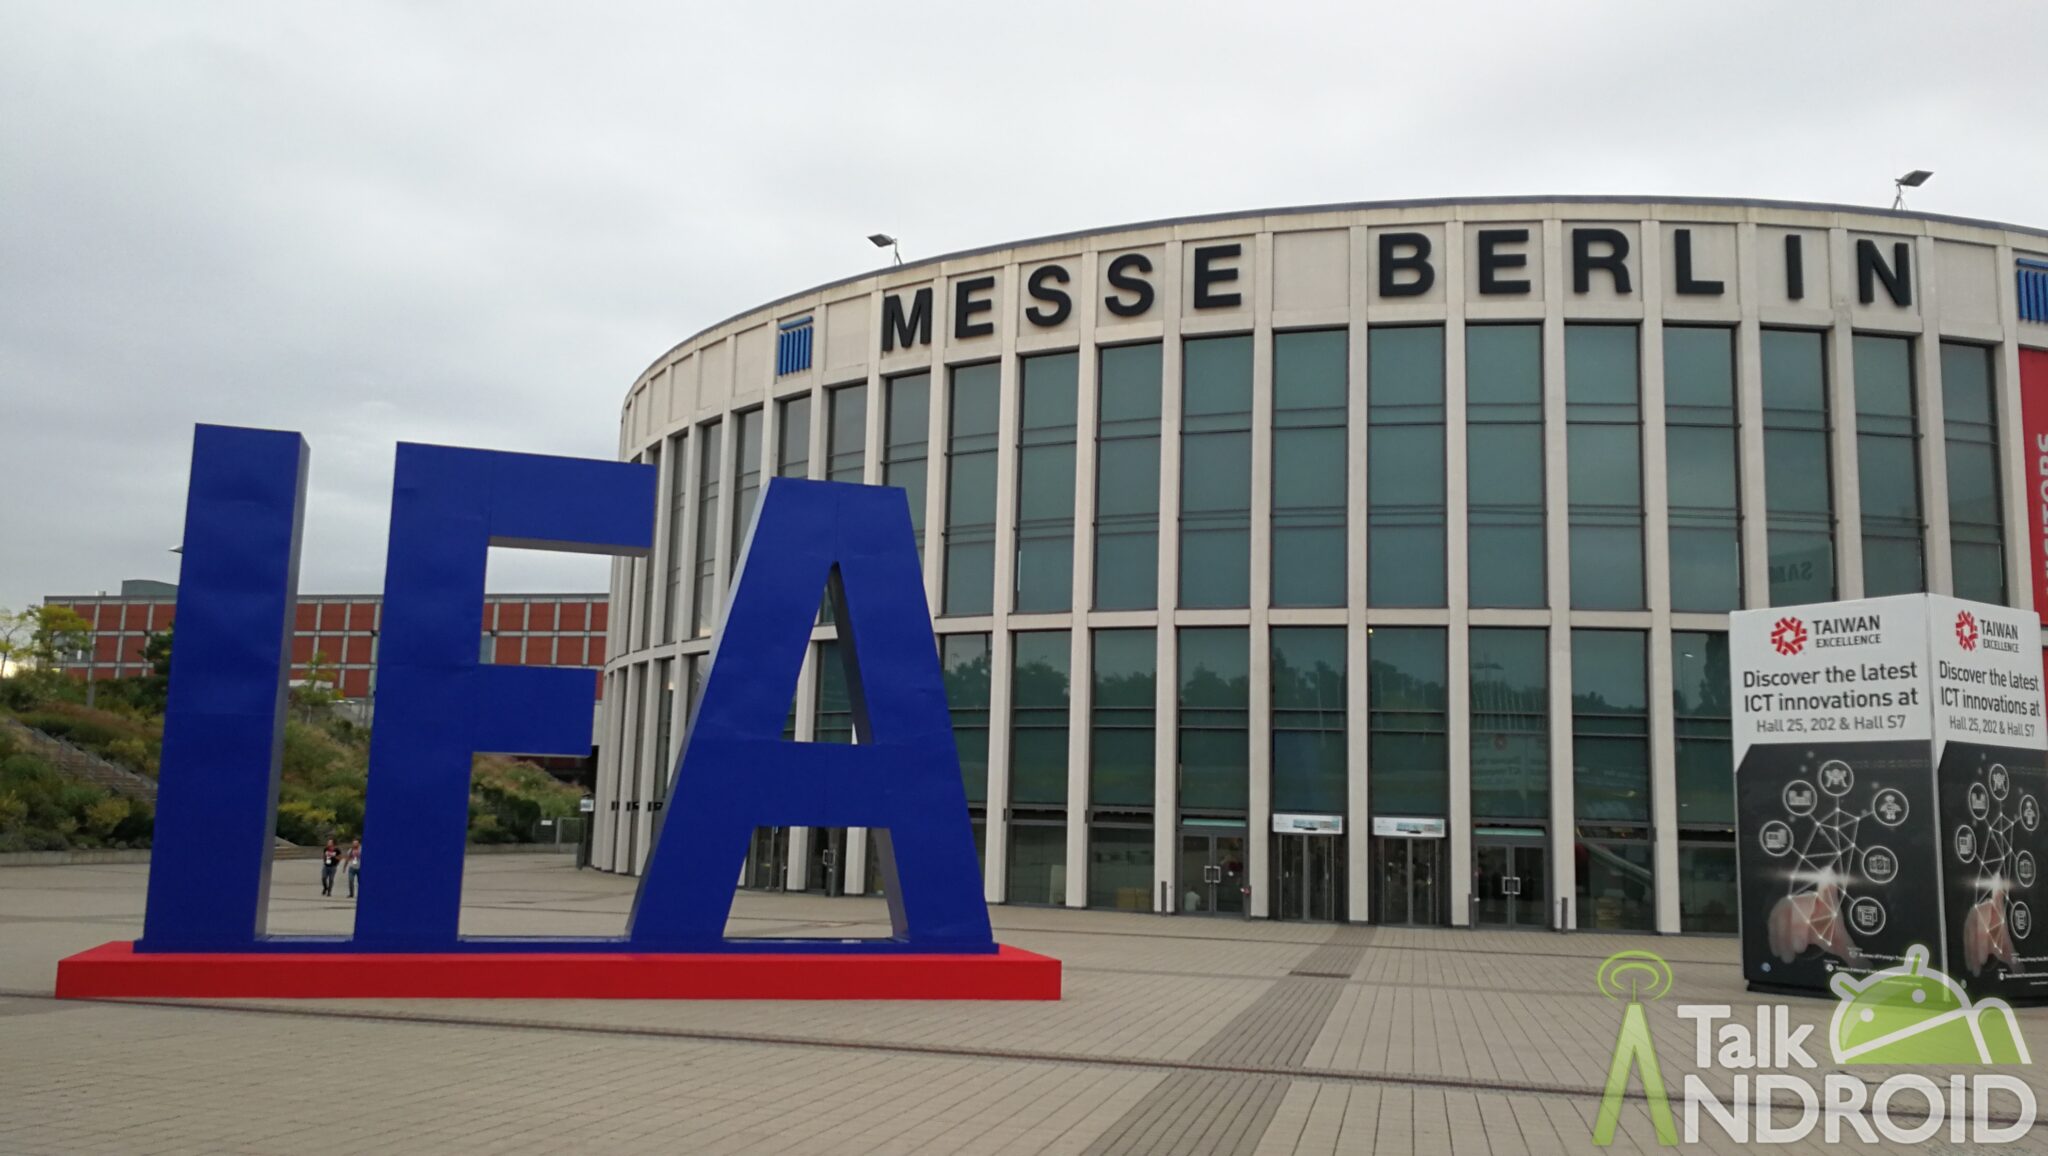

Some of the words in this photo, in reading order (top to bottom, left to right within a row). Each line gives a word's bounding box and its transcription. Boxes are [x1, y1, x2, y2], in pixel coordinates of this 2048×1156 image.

[880, 243, 1242, 352] MESSE
[1378, 228, 1913, 307] BERLIN
[1812, 614, 1881, 636] TAIWAN
[1980, 619, 2019, 640] TAIWAN
[1816, 633, 1882, 649] EXCELLENCE
[1983, 638, 2020, 654] EXCELLENCE
[1743, 669, 1821, 689] Discover
[1826, 665, 1857, 684] the
[1861, 661, 1918, 682] latest
[1939, 660, 1988, 685] Discover
[1989, 668, 2007, 688] the
[2009, 670, 2039, 692] latest
[134, 421, 998, 954] IFA
[1744, 693, 1774, 713] ICT
[1779, 689, 1893, 711] innovations
[1898, 687, 1920, 706] at
[1940, 686, 1960, 708] ICT
[1962, 689, 2028, 716] innovations
[2029, 700, 2041, 717] at
[1756, 719, 1784, 733] Hall
[1786, 718, 1808, 733] 25,
[1811, 717, 1837, 732] 202
[1839, 716, 1851, 731] &
[1854, 715, 1884, 730] Hall
[1887, 714, 1907, 729] S7
[1949, 715, 1967, 731] Hall
[1968, 717, 1982, 734] 25,
[1982, 718, 1998, 735] 202
[1999, 720, 2006, 735] &
[2007, 721, 2024, 737] Hall
[2025, 723, 2036, 738] S7
